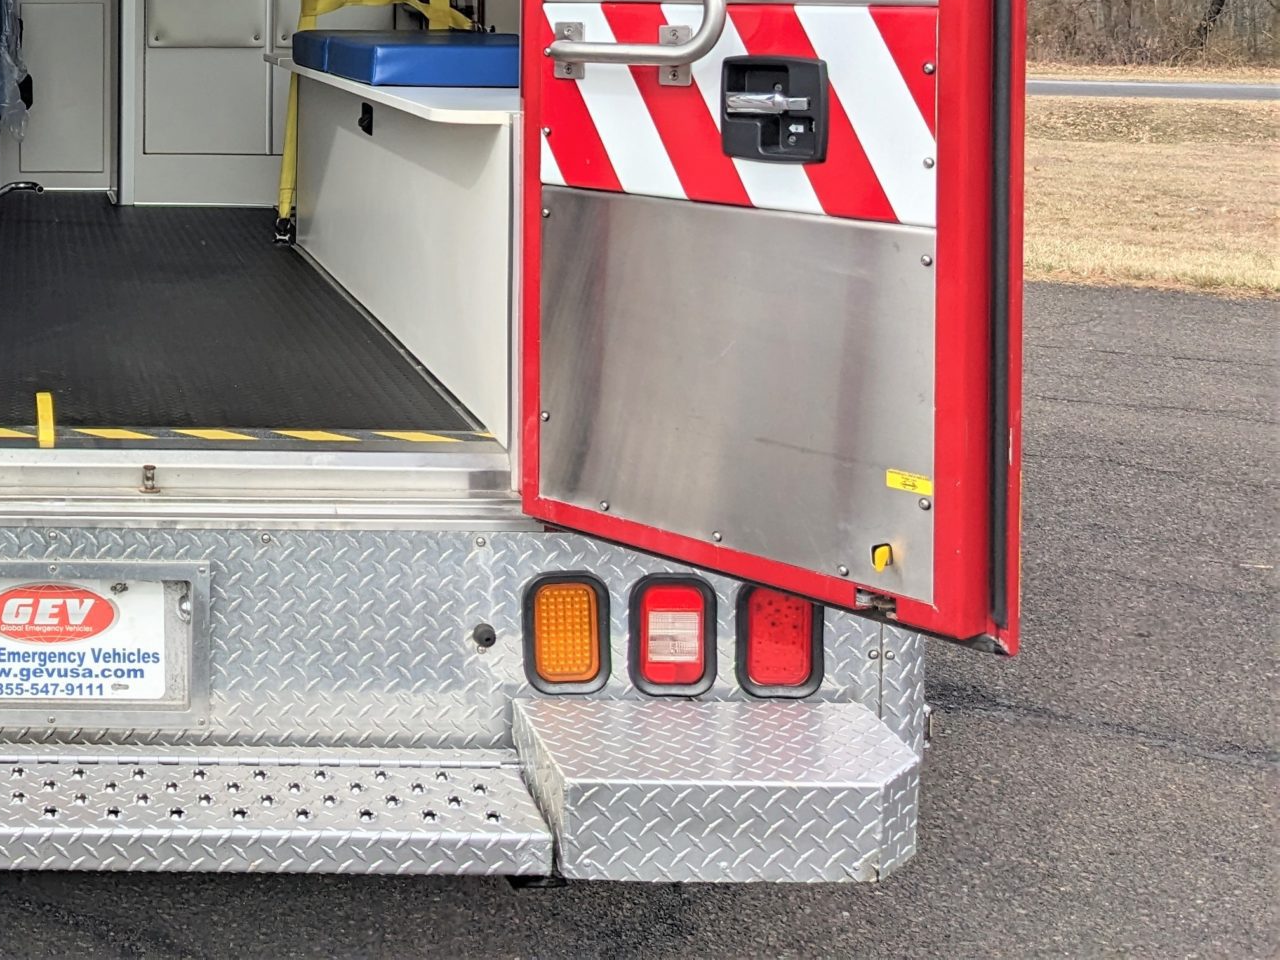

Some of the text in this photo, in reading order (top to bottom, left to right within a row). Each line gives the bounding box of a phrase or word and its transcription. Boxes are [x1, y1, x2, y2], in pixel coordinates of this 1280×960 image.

[1, 598, 95, 625] GEV
[0, 624, 93, 635] Global Emergency Vehicles
[91, 647, 160, 664] Vehicles
